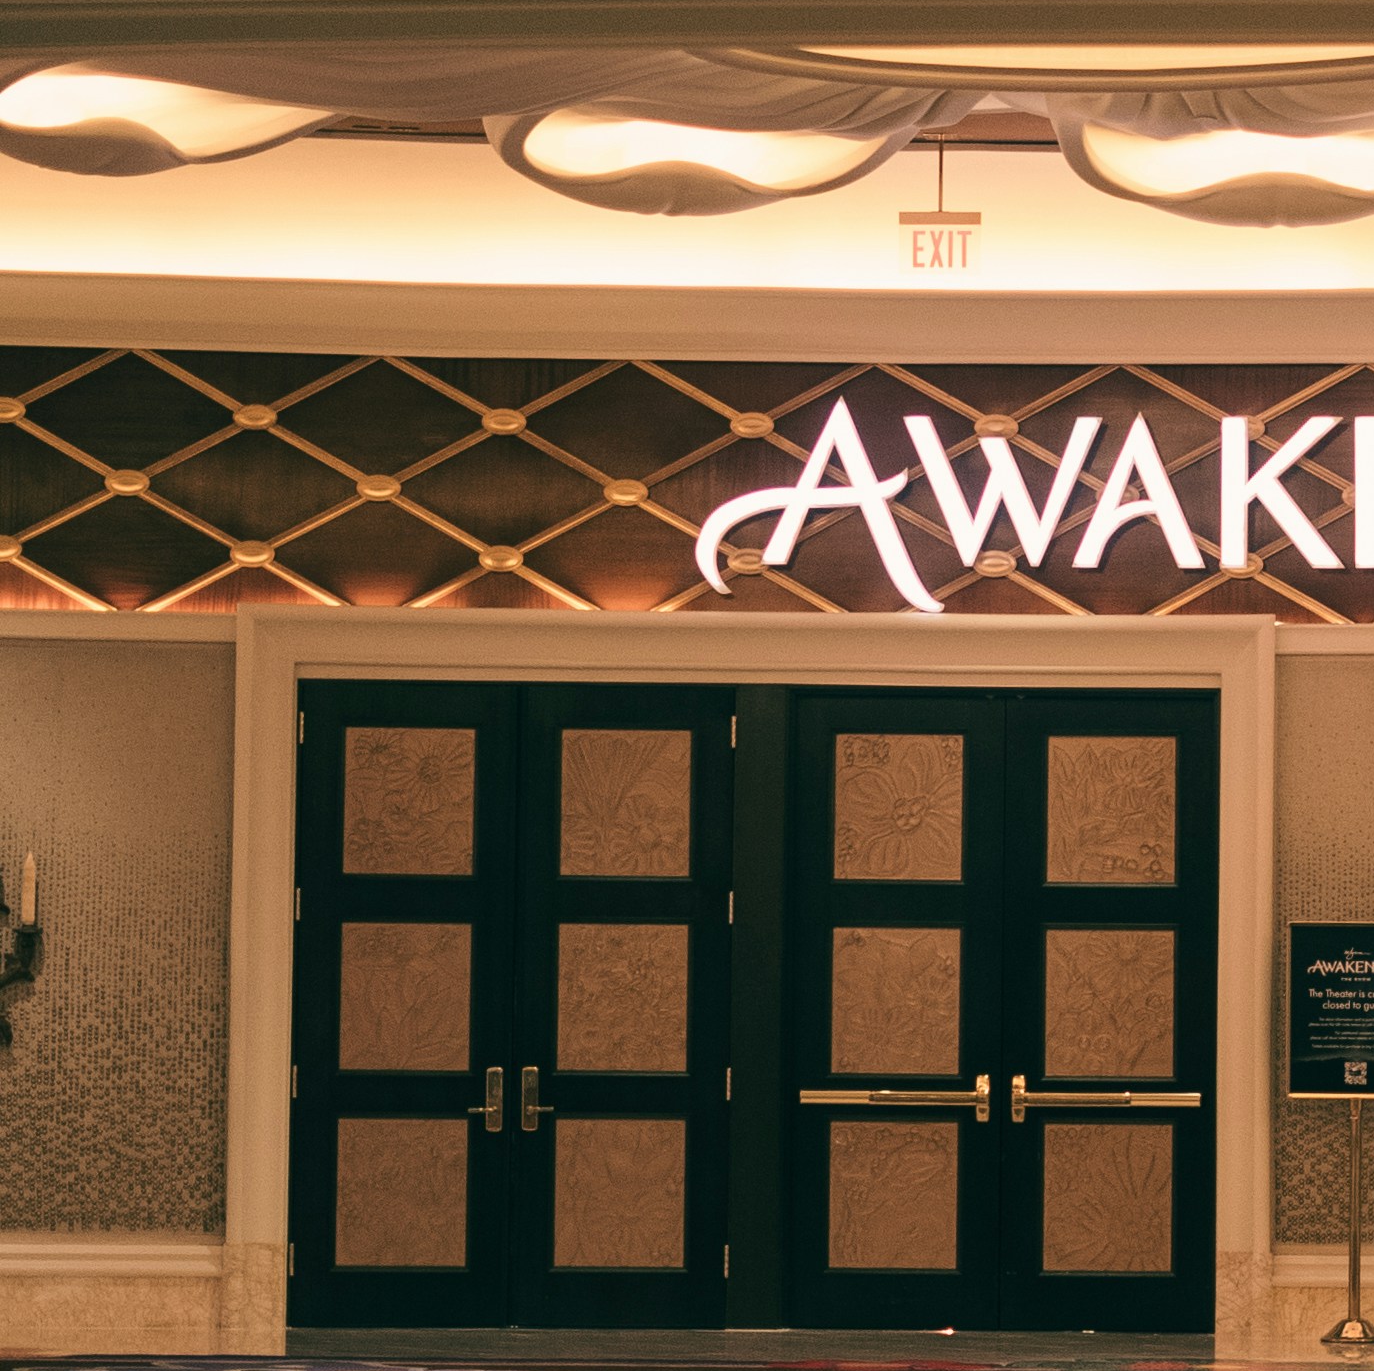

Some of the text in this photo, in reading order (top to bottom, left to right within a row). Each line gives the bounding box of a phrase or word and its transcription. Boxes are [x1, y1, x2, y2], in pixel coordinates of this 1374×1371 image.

[913, 230, 973, 268] EXIT
[1308, 988, 1323, 998] The
[1325, 988, 1357, 998] Theater
[1358, 989, 1366, 998] is
[1322, 1000, 1351, 1010] closed
[1352, 1001, 1362, 1010] to
